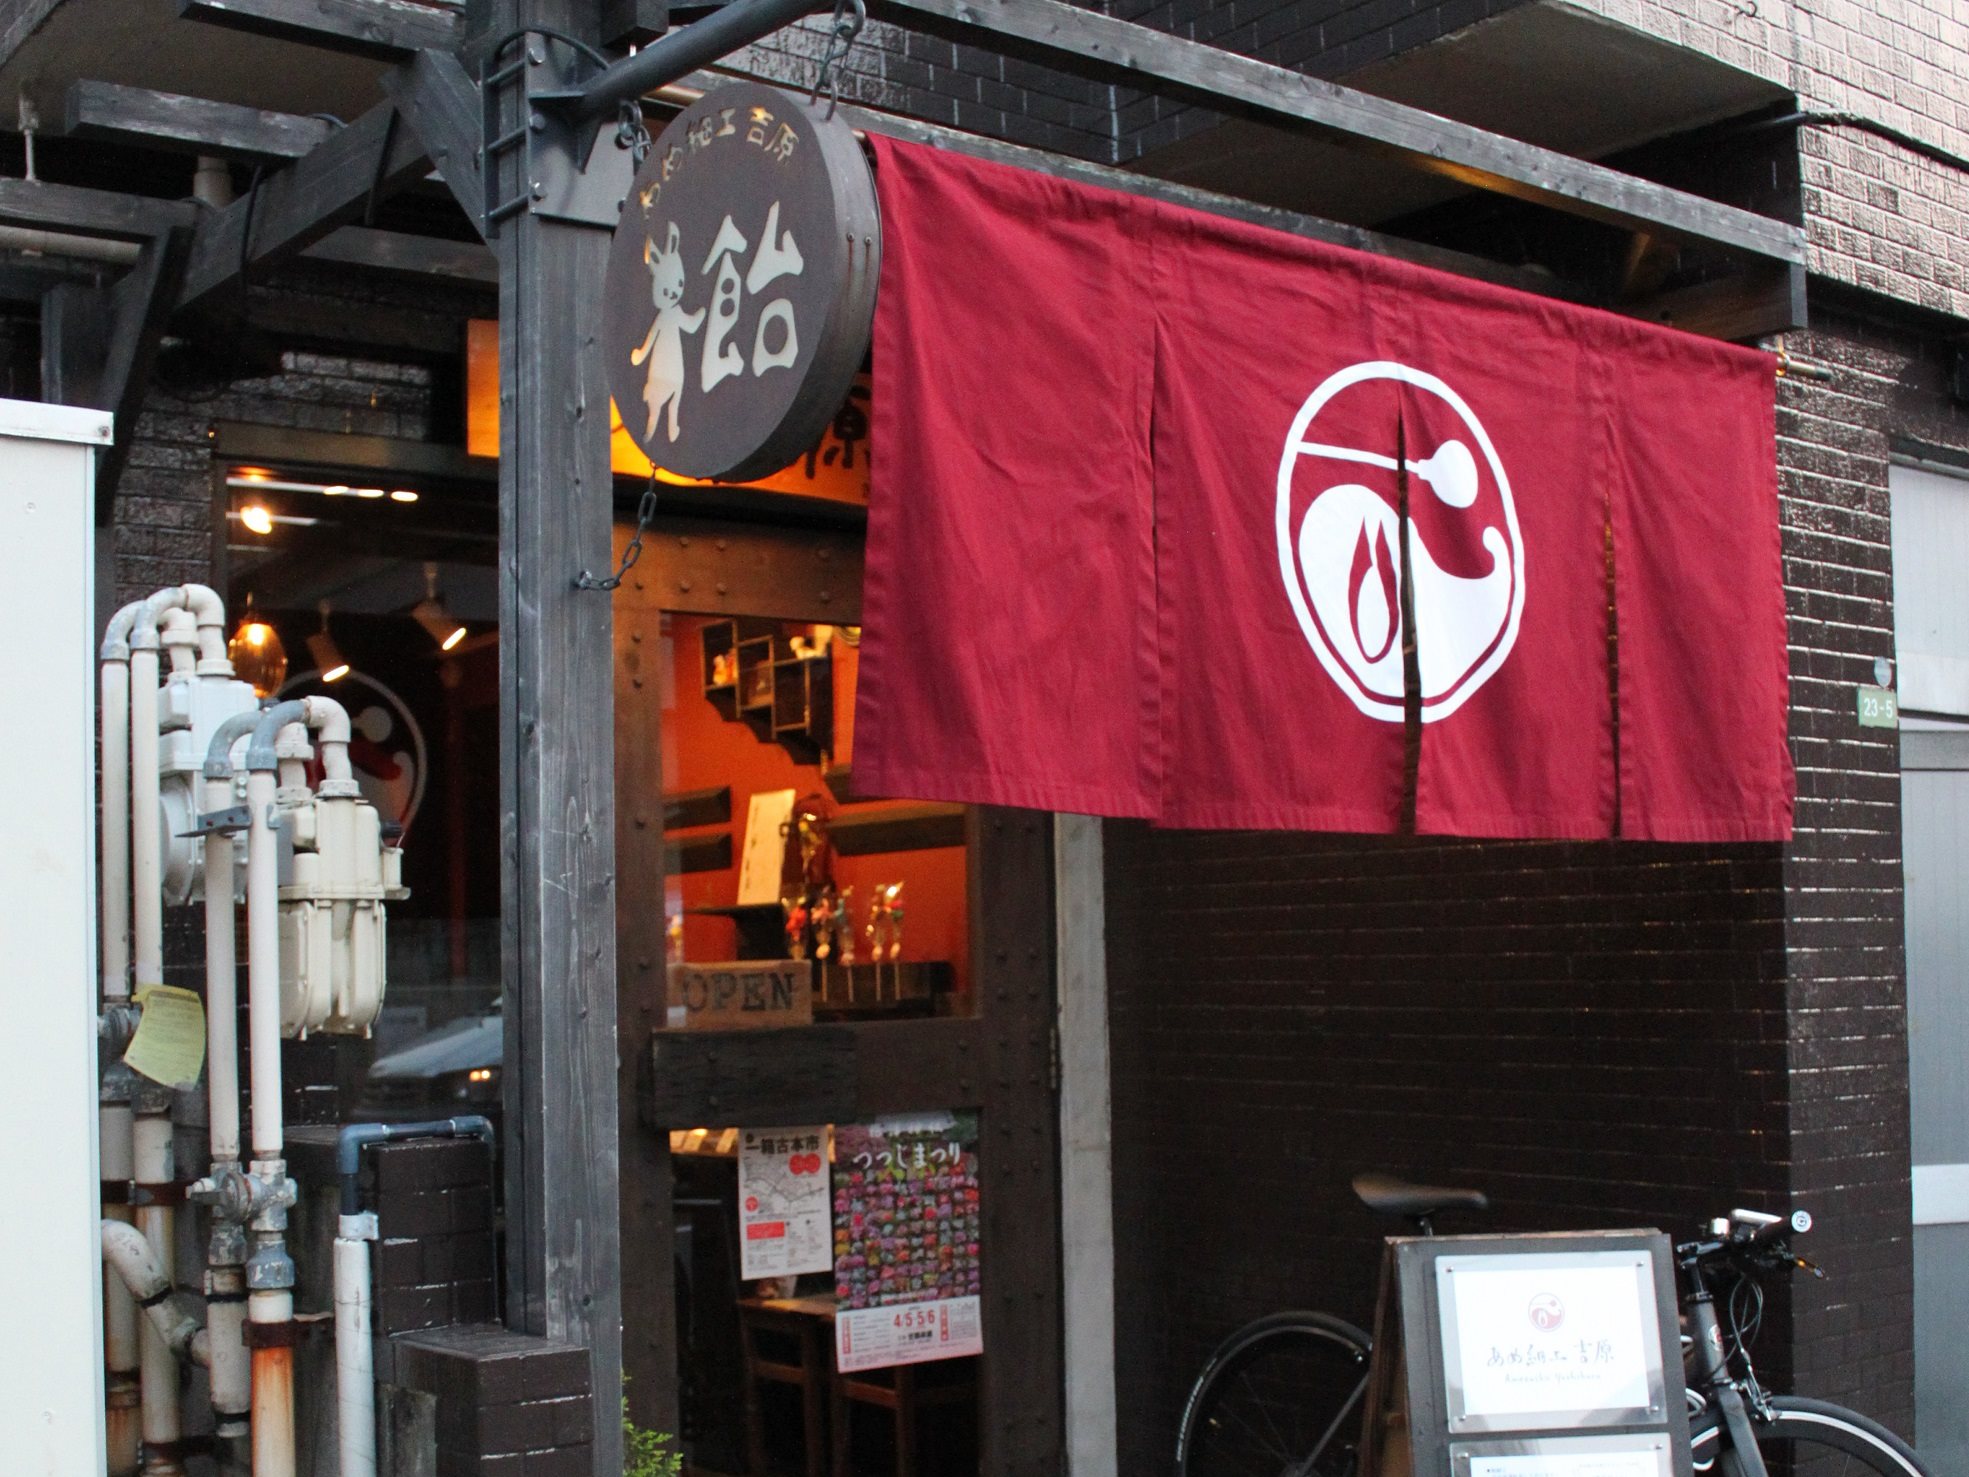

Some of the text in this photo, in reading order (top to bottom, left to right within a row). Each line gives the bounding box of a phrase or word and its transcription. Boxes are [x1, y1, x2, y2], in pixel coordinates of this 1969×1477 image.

[700, 200, 805, 394] 飴
[1863, 697, 1894, 719] 23-5
[681, 971, 795, 1012] OPEN
[853, 1142, 961, 1169] つつじまつり
